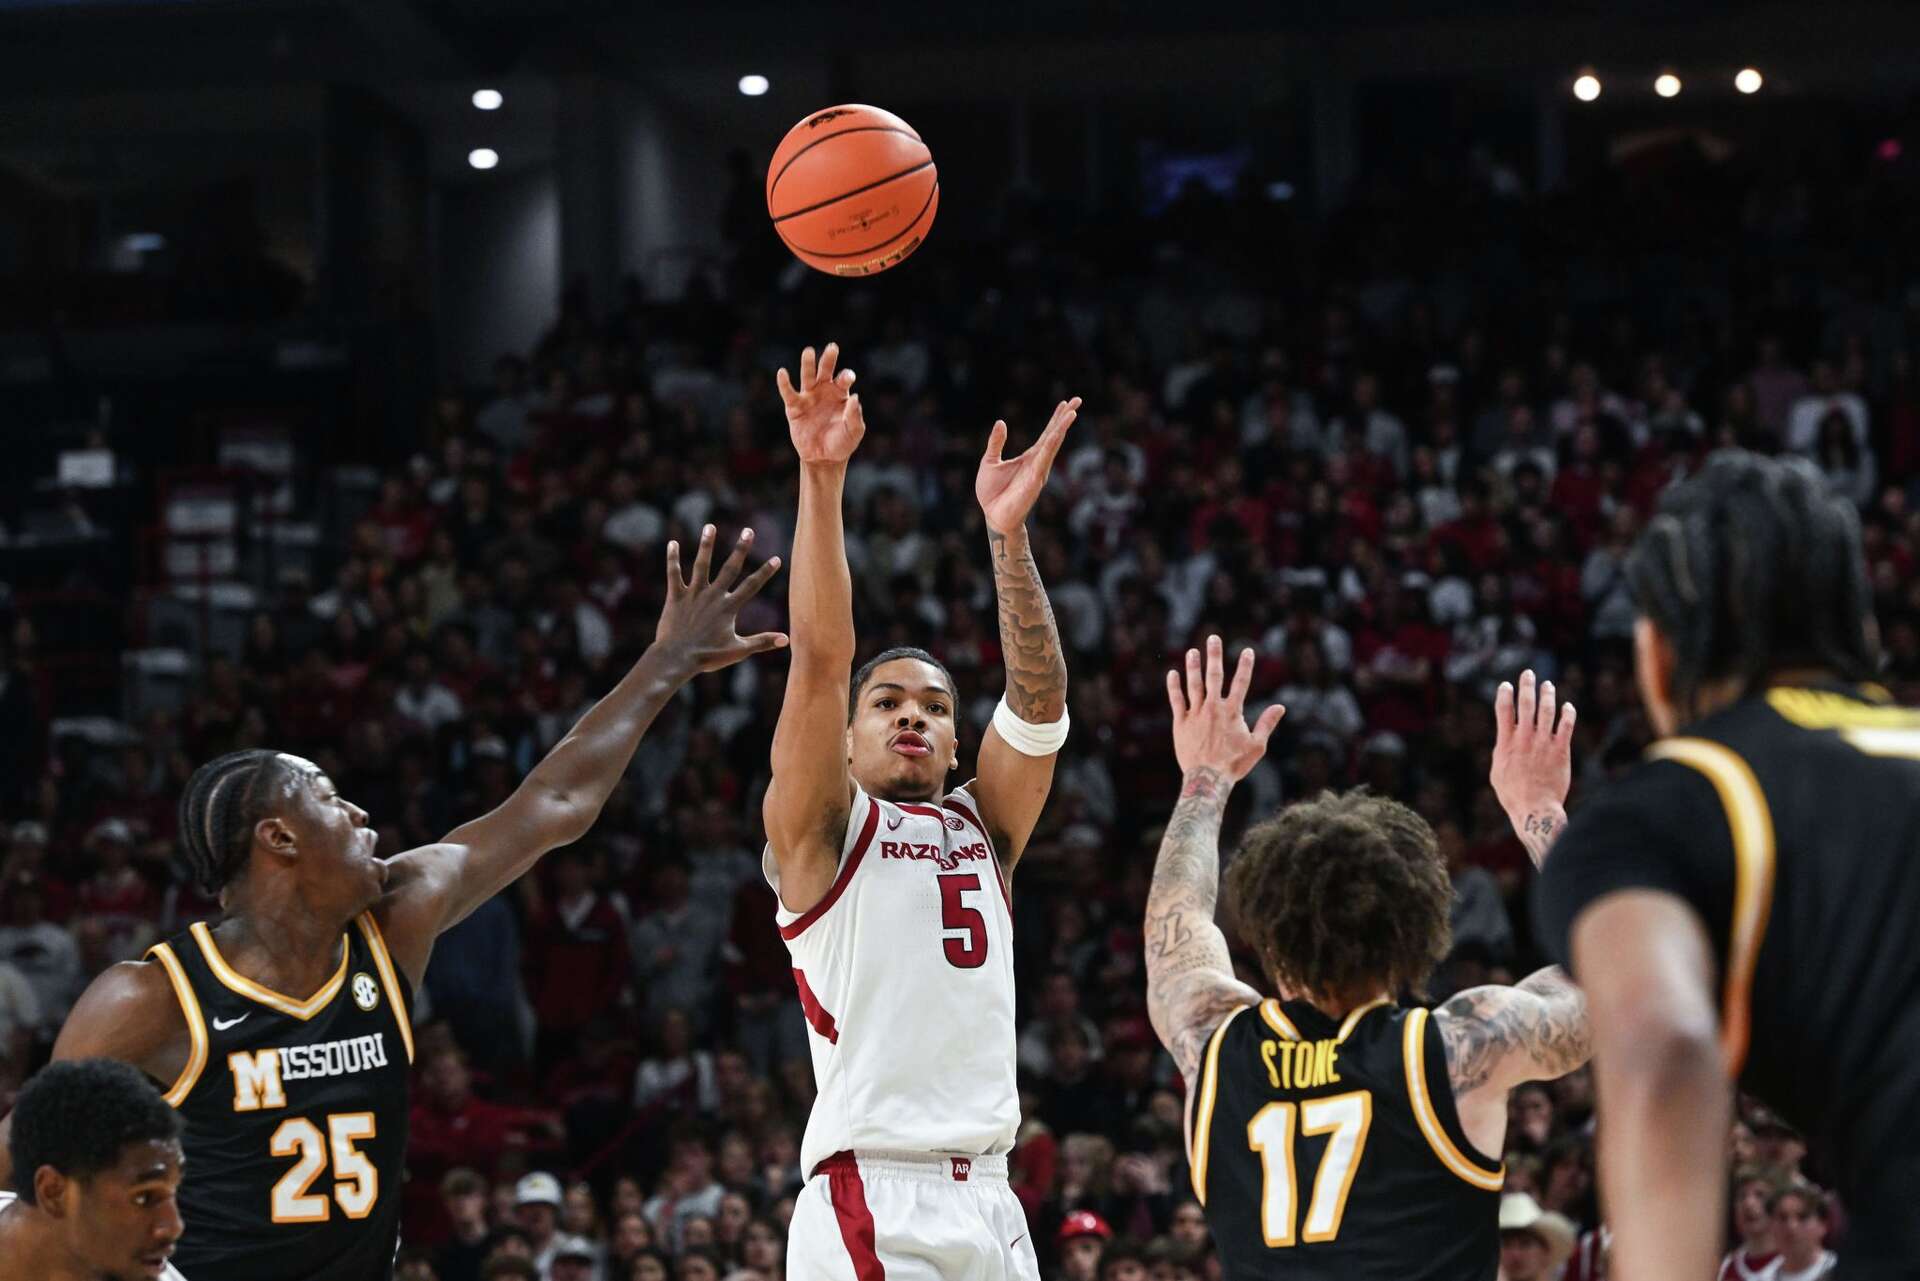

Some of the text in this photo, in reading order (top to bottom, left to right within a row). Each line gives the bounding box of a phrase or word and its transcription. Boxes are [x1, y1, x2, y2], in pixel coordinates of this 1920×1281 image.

[936, 874, 988, 968] 5
[228, 1033, 388, 1111] MISSOURI
[1261, 1039, 1340, 1089] STONE
[270, 1112, 378, 1223] 25
[1247, 1090, 1372, 1248] 17
